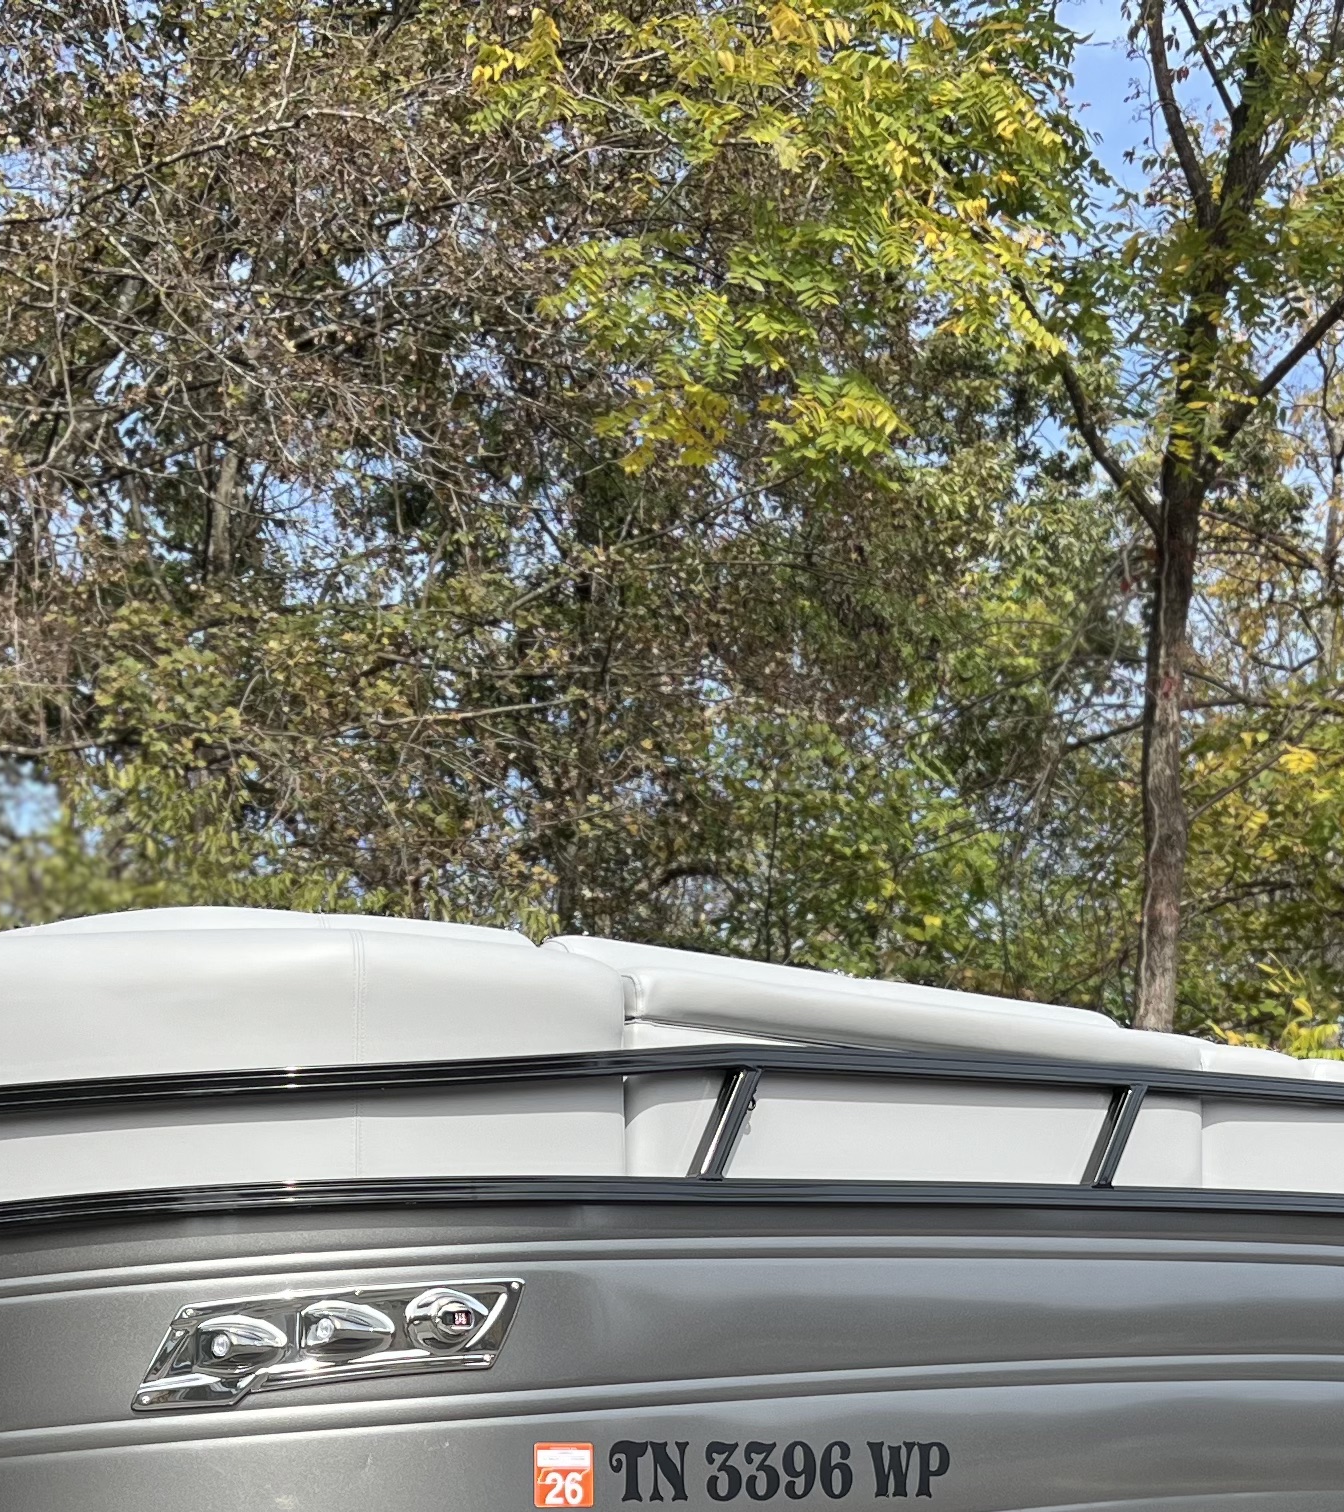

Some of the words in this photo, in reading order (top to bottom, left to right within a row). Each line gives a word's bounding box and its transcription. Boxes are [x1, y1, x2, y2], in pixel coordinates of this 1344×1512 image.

[544, 1471, 584, 1505] 26
[608, 1440, 690, 1503] TN
[704, 1440, 853, 1502] 3396
[866, 1440, 951, 1499] WP
